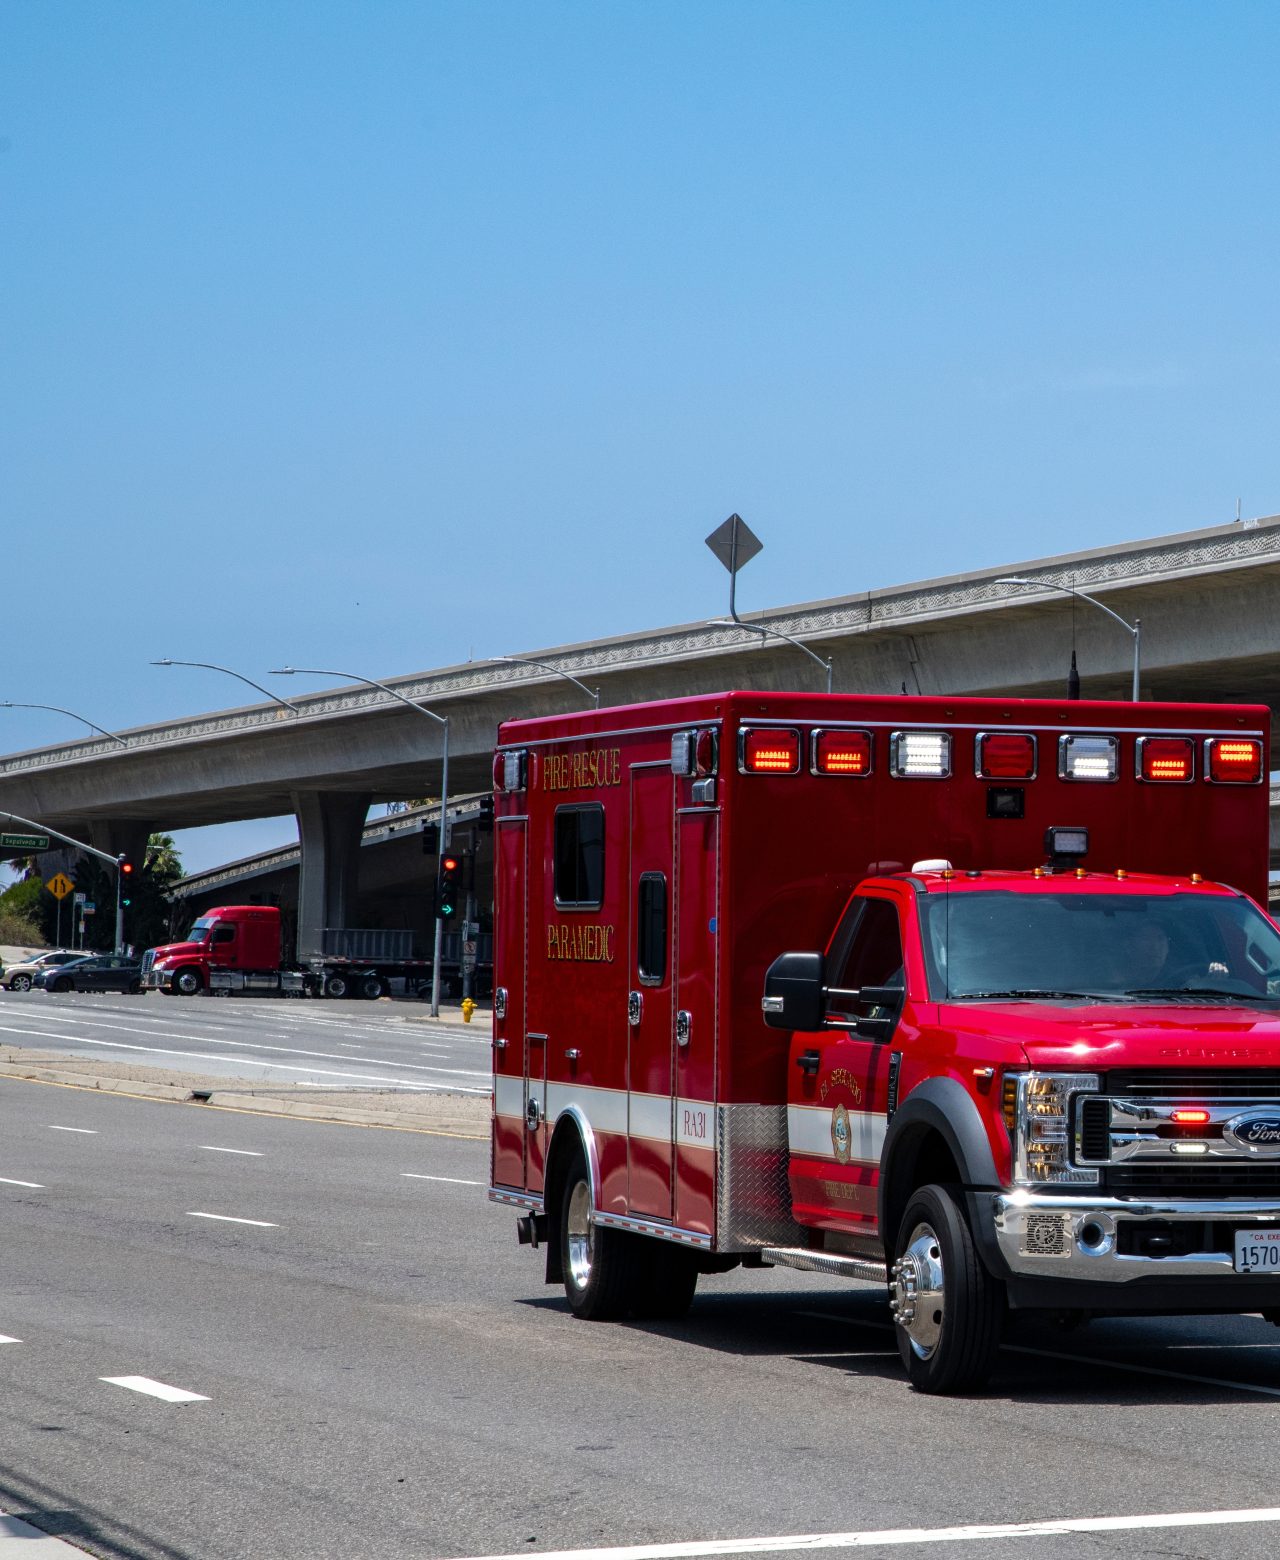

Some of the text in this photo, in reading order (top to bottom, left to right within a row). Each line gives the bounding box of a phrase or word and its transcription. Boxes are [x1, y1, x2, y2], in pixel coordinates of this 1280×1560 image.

[543, 748, 621, 791] FIRE/RESCUE
[547, 924, 615, 962] PARAMEDIC
[1160, 1048, 1273, 1059] SUPER
[684, 1110, 706, 1139] RA31
